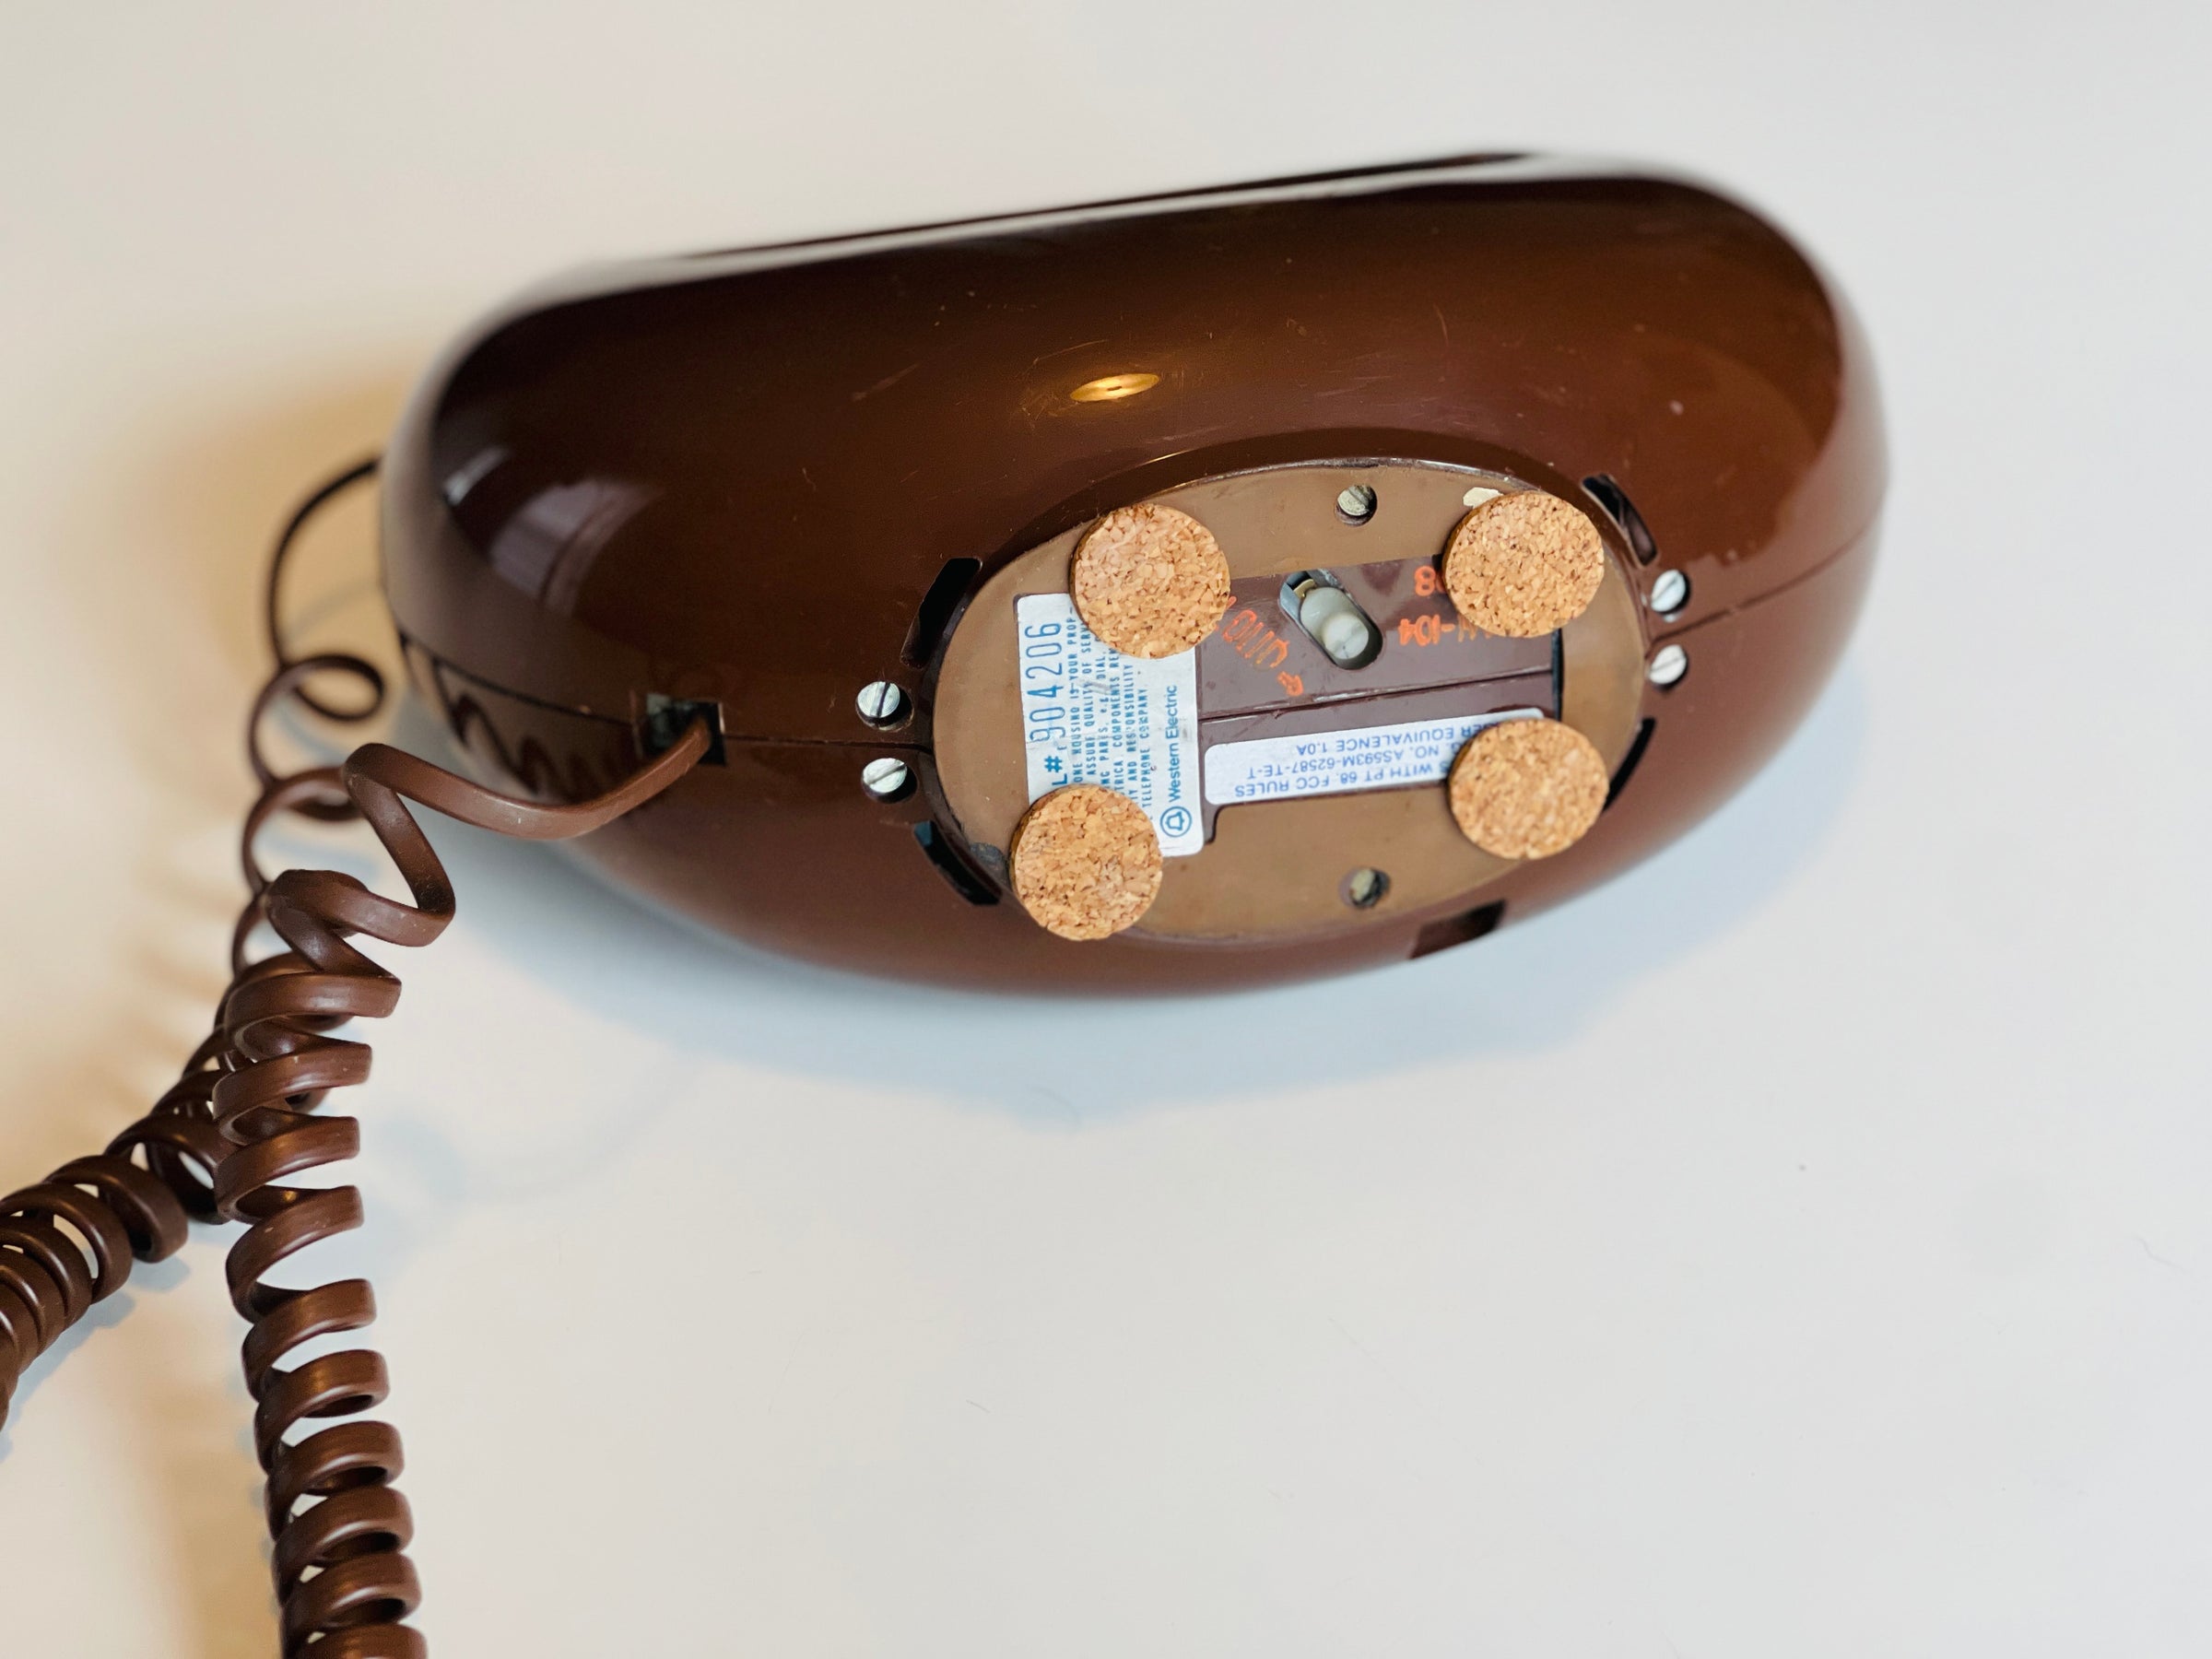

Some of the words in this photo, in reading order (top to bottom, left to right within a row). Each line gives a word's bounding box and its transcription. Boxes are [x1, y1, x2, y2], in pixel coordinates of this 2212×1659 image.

[1067, 654, 1078, 680] YOUR
[1082, 663, 1091, 674] OF
[1025, 623, 1065, 742] 904206
[1083, 683, 1095, 726] QUALITY
[1110, 677, 1123, 747] COMPONENTS
[1123, 665, 1136, 752] RESONSIBILITY
[1165, 685, 1180, 739] Electric
[1296, 742, 1327, 756] 1.0A
[1336, 728, 1454, 752] EQUIVALENCE
[1409, 745, 1439, 759] NO.
[1043, 756, 1067, 785] L#
[1073, 763, 1083, 782] ONE
[1126, 761, 1137, 781] AND
[1167, 743, 1181, 803] Western
[1246, 748, 1404, 780] AS593M-62587-TE-T
[1390, 763, 1432, 778] WITH
[1439, 761, 1449, 773] S
[1100, 771, 1110, 789] NG
[1139, 747, 1152, 807] TELEPHONE
[1295, 774, 1329, 791] FCC
[1364, 769, 1383, 782] PT
[1234, 780, 1289, 798] RULES
